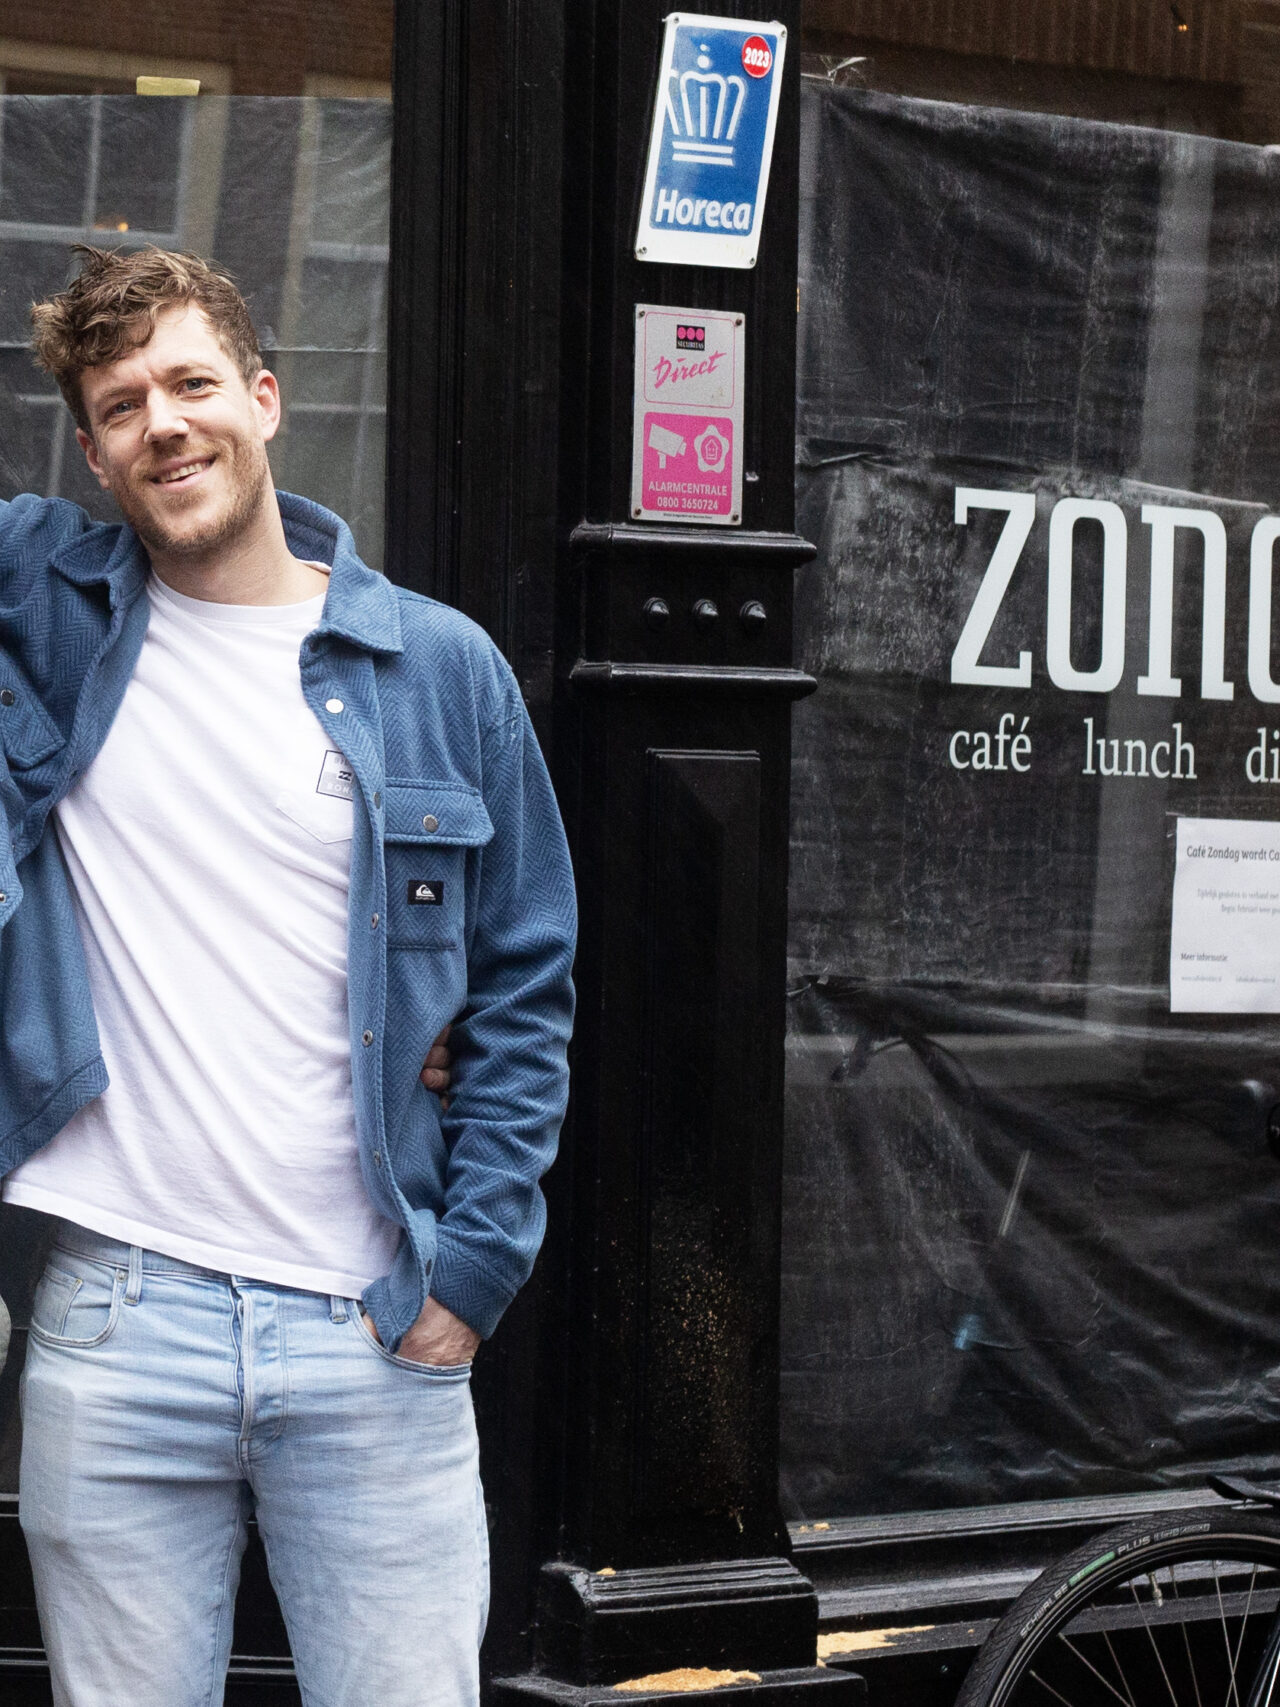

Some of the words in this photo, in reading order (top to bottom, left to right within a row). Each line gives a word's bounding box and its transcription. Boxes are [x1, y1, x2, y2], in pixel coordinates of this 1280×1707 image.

[745, 47, 770, 67] 2023
[655, 188, 752, 230] Horeca
[653, 351, 727, 389] Direct
[648, 480, 727, 496] ALARMCENTRALE
[657, 496, 679, 508] 0800
[681, 498, 718, 511] 3650724
[949, 713, 1032, 772] café
[1082, 718, 1197, 779] lunch
[1186, 844, 1206, 858] Café
[1207, 845, 1240, 863] Zondag
[1241, 848, 1267, 861] wordt
[1117, 1534, 1152, 1556] PLUS
